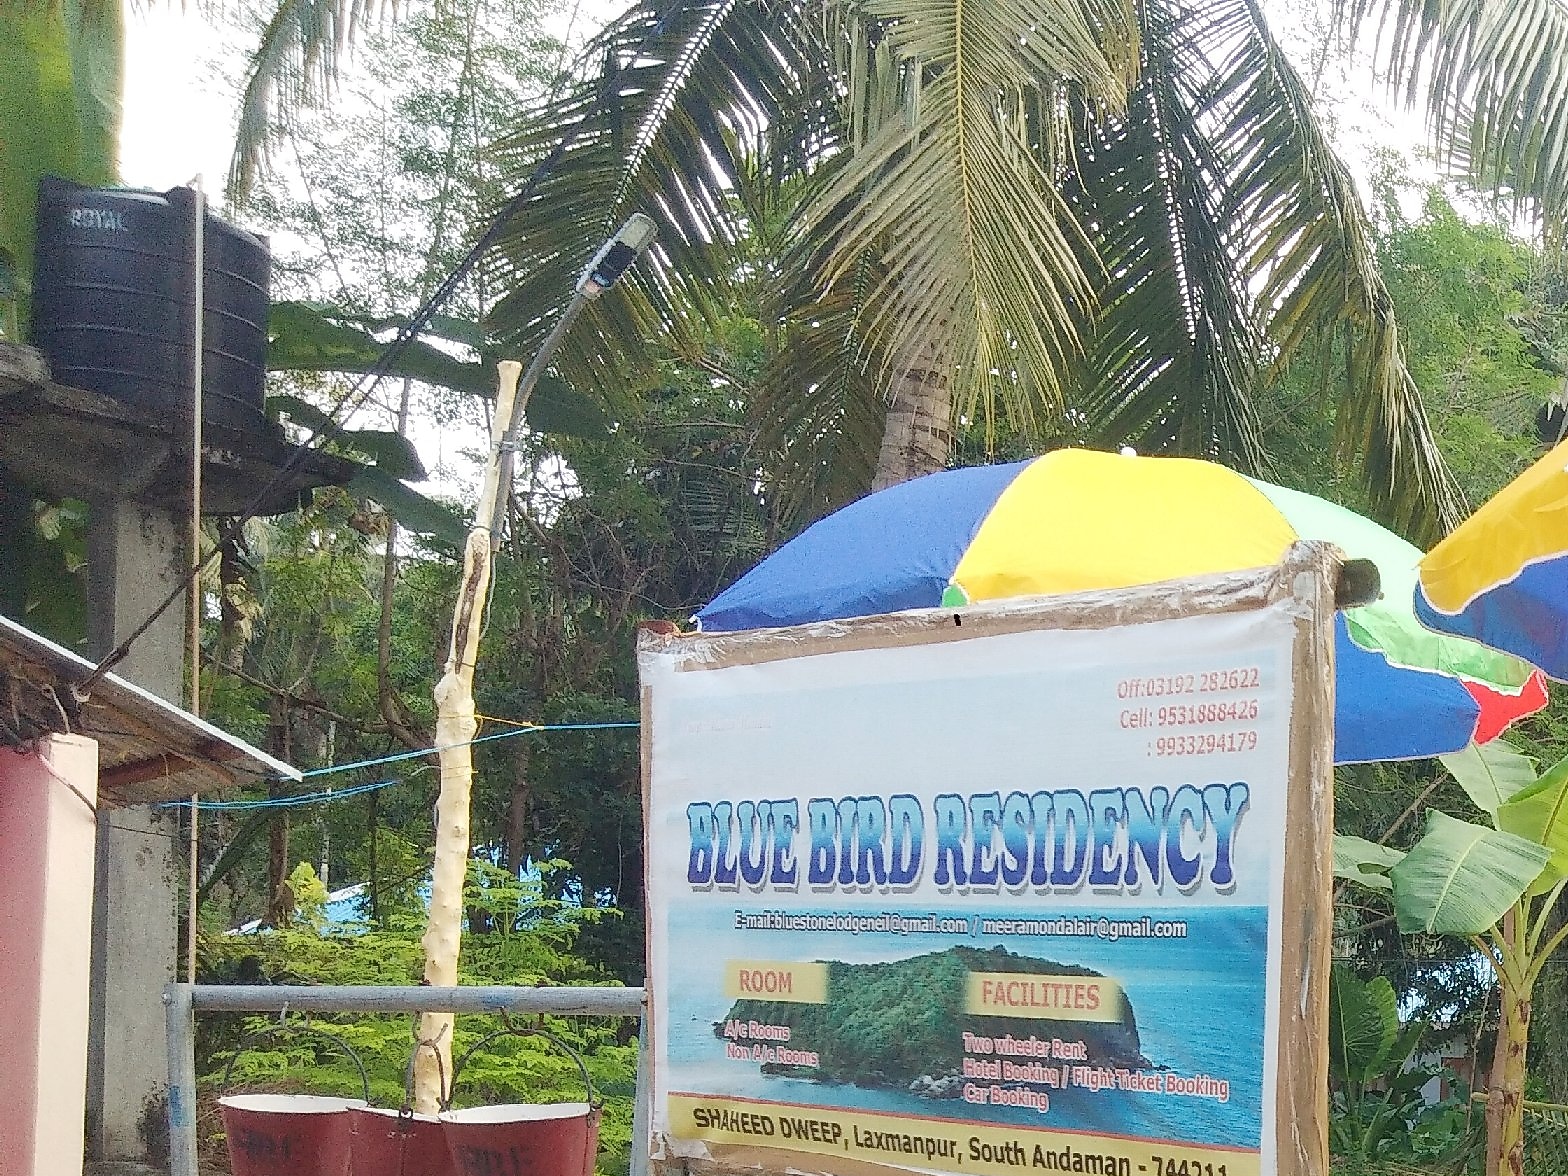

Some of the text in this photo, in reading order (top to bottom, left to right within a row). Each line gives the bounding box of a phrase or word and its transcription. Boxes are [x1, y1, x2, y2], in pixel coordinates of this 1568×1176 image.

[1199, 668, 1260, 692] 282622
[1120, 699, 1258, 729] Cell: 9531888426
[686, 782, 1250, 892] BLUE BIRD RESIDENCY
[982, 915, 1188, 942] meeramondalair@gmail.com
[740, 969, 793, 993] ROOM
[981, 980, 1101, 1010] FACILITIES
[724, 1020, 791, 1041] A/c Rooms
[726, 1042, 819, 1067] Non A/c Rooms
[962, 1032, 1088, 1061] Two wheeler Rent
[963, 1058, 1000, 1080] Hotel
[1002, 1060, 1060, 1089] Booking
[1073, 1066, 1116, 1092] Flight
[1115, 1069, 1162, 1092] Ticket
[1165, 1074, 1230, 1102] Booking
[963, 1083, 1049, 1113] Car Booking
[693, 1108, 775, 1136] SHAHEED
[779, 1117, 849, 1150] DWEEP,
[853, 1124, 962, 1165] Laxmanpur,
[969, 1136, 1027, 1167] South
